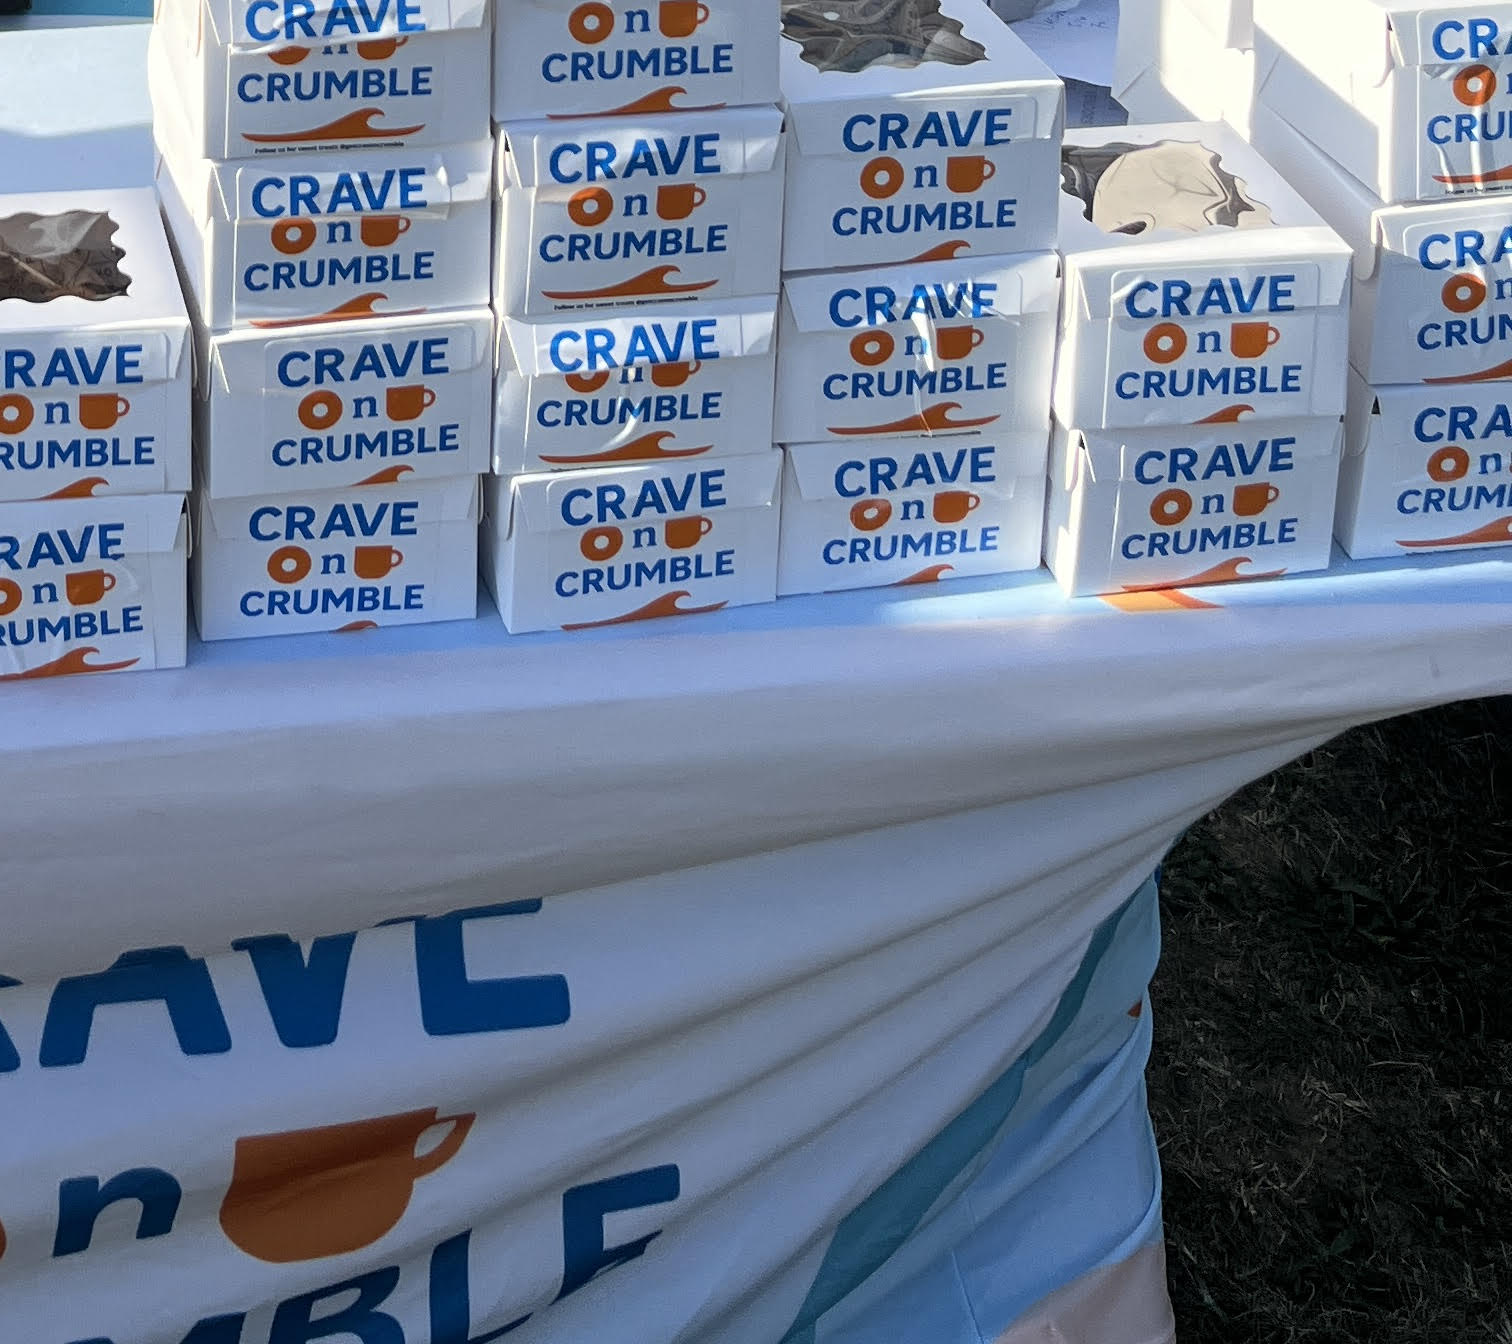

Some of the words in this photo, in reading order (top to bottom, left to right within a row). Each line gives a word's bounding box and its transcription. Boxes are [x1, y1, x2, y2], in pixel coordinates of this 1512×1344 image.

[237, 66, 432, 103] CRUMBLE
[541, 44, 733, 83] CRUMBLE
[842, 108, 1012, 153] CRAVE
[549, 133, 721, 185] CRAVE
[251, 167, 427, 218] CRAVE
[831, 199, 1017, 237] CRUMBLE
[539, 224, 728, 263] CRUMBLE
[243, 251, 435, 292] CRUMBLE
[829, 282, 997, 328] CRAVE
[1125, 274, 1295, 319] CRAVE
[277, 337, 449, 388] CRAVE
[549, 319, 720, 373] CRAVE
[823, 363, 1006, 401] CRUMBLE
[1115, 365, 1302, 400] CRUMBLE
[536, 391, 722, 428] CRUMBLE
[271, 423, 459, 467] CRUMBLE
[1134, 437, 1296, 485] CRAVE
[834, 447, 996, 499] CRAVE
[561, 469, 727, 527] CRAVE
[248, 501, 419, 542] CRAVE
[1121, 517, 1298, 560] CRUMBLE
[822, 526, 1000, 566] CRUMBLE
[555, 549, 735, 598] CRUMBLE
[239, 584, 425, 618] CRUMBLE
